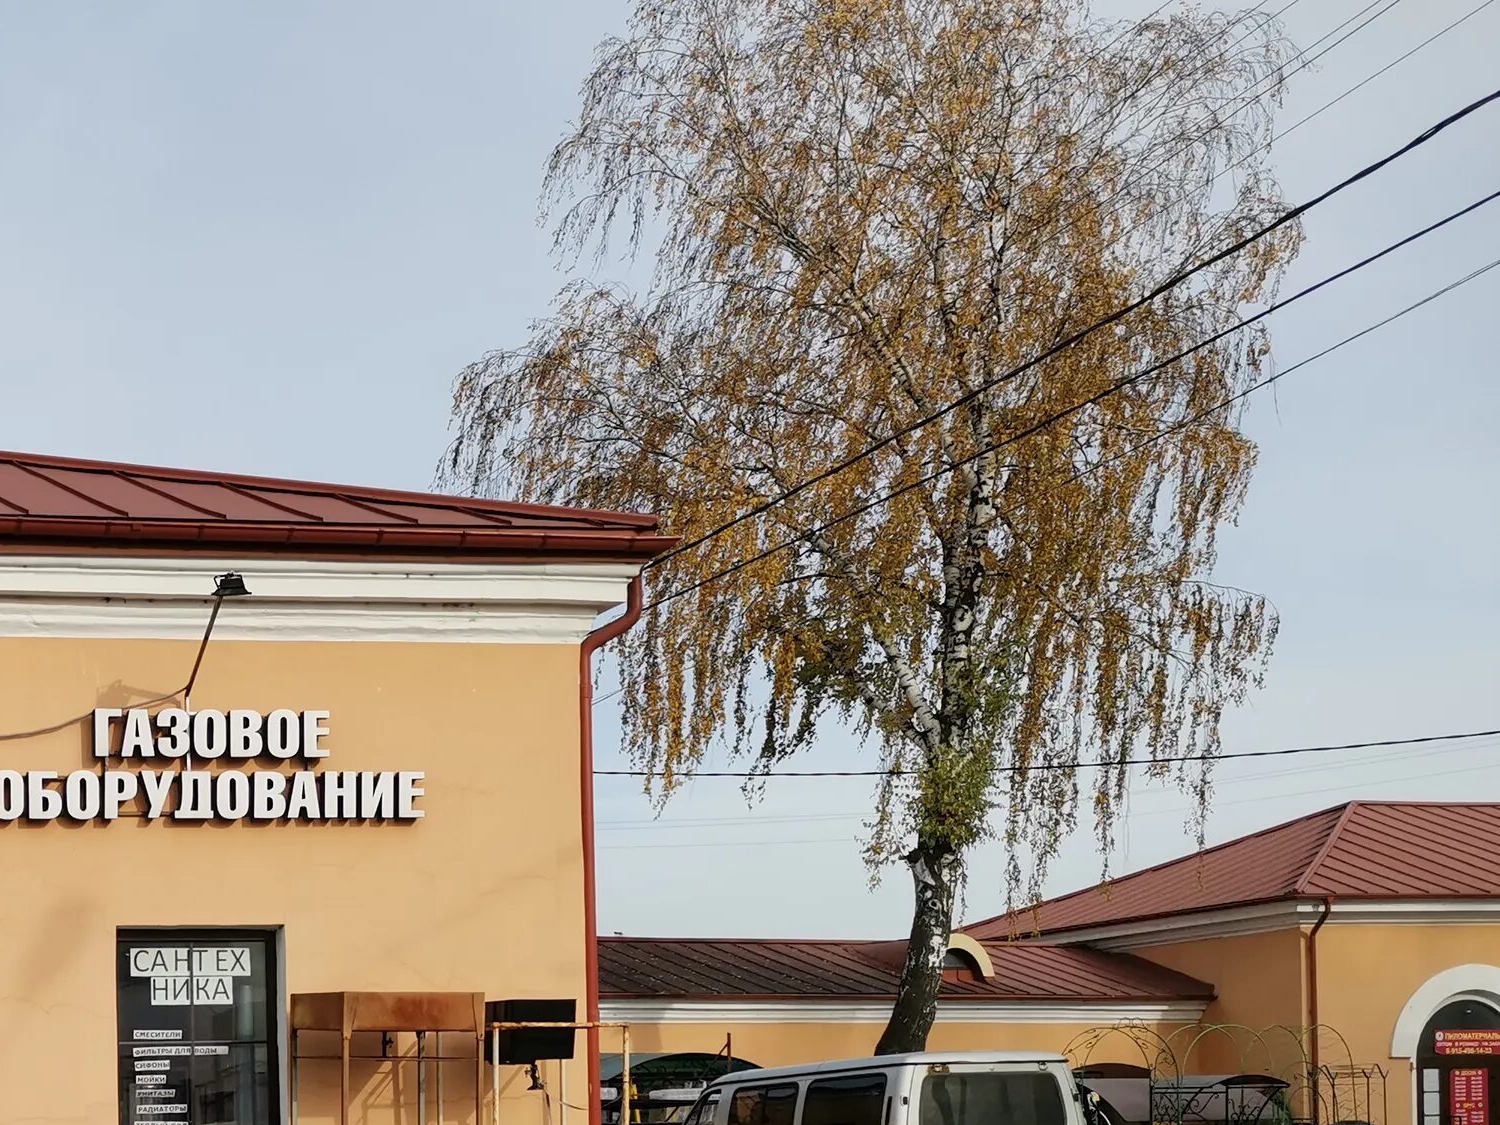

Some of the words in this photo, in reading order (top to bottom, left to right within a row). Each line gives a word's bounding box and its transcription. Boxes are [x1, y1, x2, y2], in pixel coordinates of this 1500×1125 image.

[93, 707, 331, 759] ГАЗОВОЕ
[133, 949, 246, 972] САНТЕХ
[152, 978, 230, 1001] НИКА
[134, 1031, 181, 1039] СМЕСИТЕЛИ
[134, 1047, 173, 1056] ФИЛЬТРЫ
[174, 1047, 192, 1055] ДЛЯ
[194, 1047, 217, 1055] ВОДЫ
[135, 1061, 170, 1070] СИФОНЫ
[138, 1105, 187, 1113] РАДИАТОРЫ
